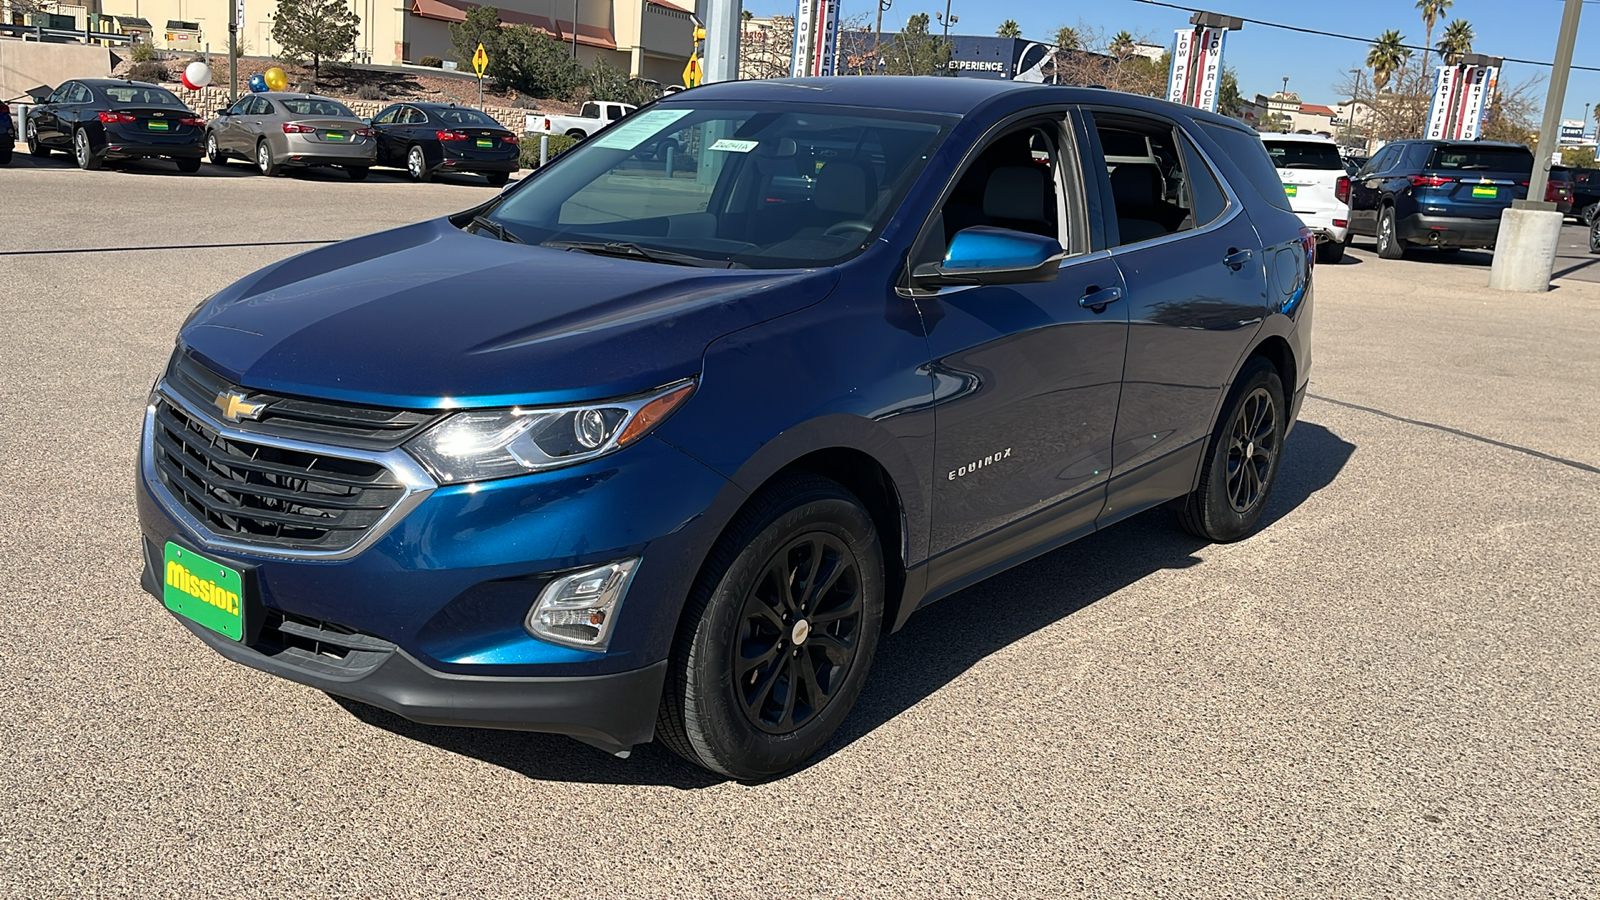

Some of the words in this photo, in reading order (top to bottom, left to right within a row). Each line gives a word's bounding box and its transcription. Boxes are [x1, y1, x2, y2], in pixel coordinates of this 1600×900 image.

[797, 22, 808, 77] OWNED
[1178, 34, 1187, 57] LOW
[1208, 32, 1220, 56] LOW
[948, 60, 1003, 71] EXPERIENCE
[1432, 69, 1451, 137] CERTIFIED
[1465, 69, 1485, 138] CERTIFIED
[948, 447, 1011, 480] EQUINOX
